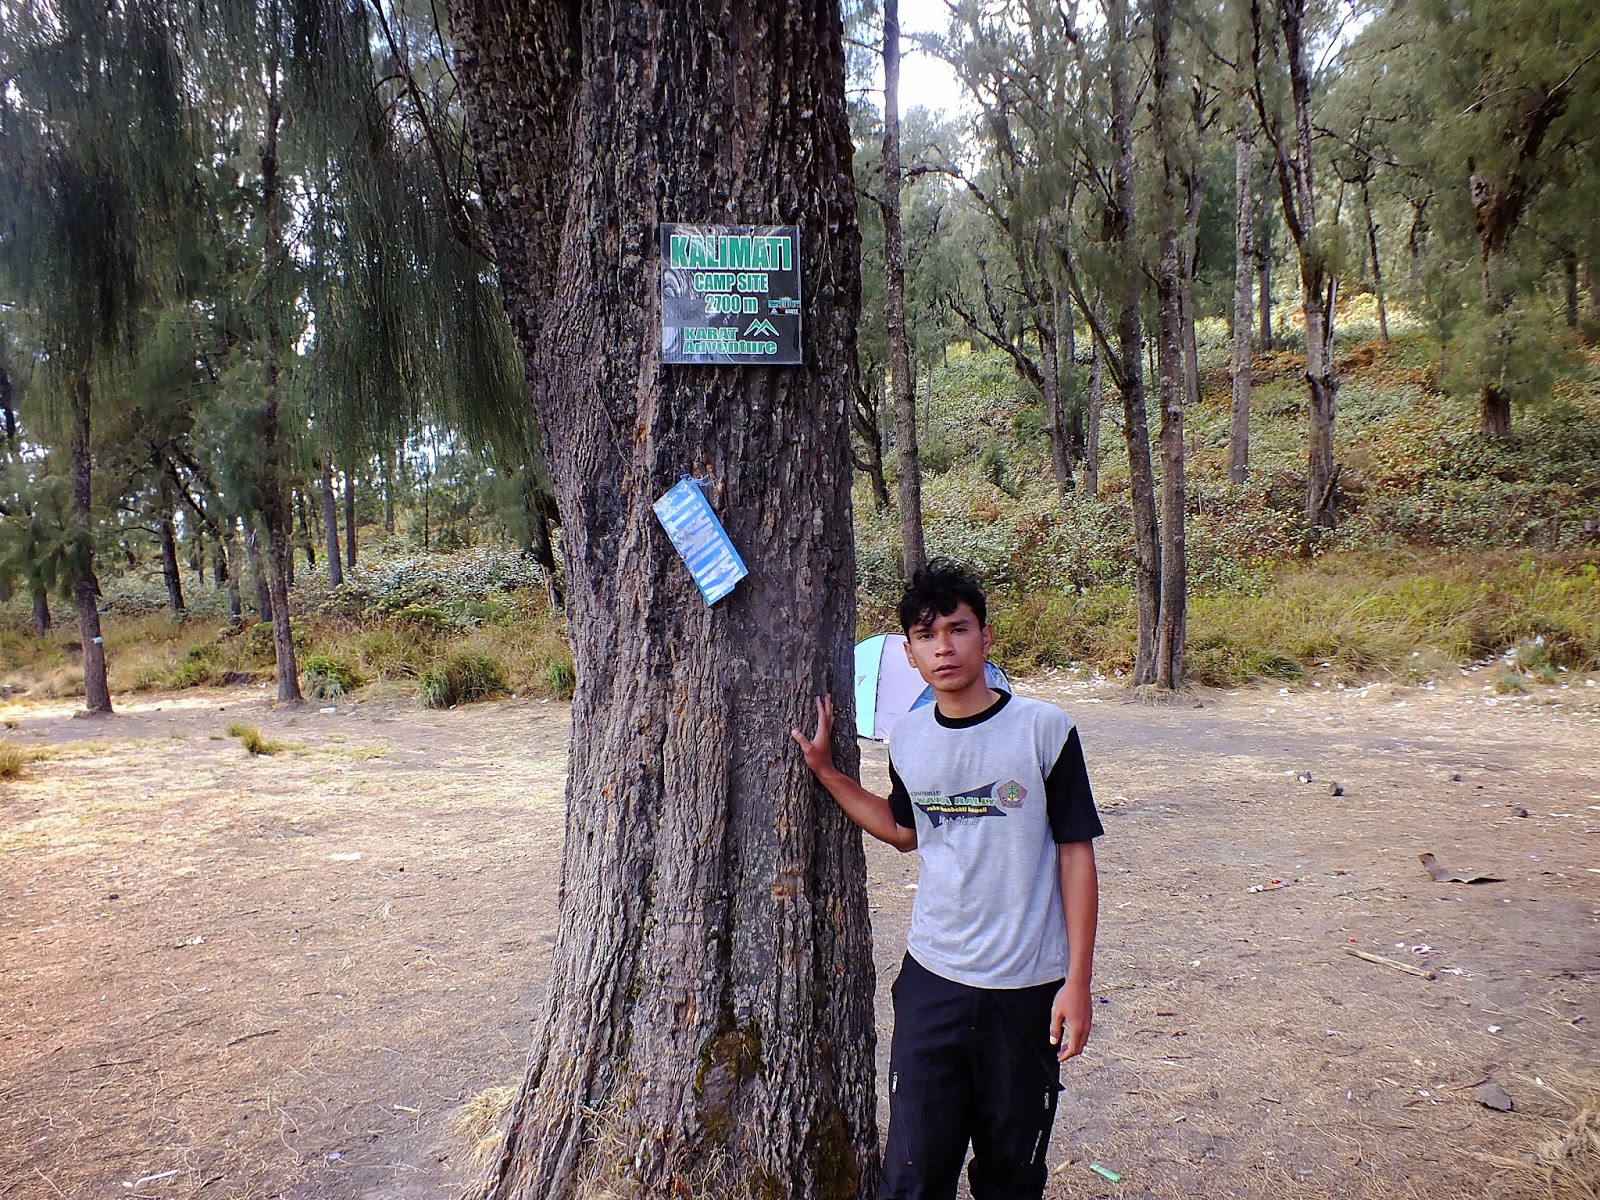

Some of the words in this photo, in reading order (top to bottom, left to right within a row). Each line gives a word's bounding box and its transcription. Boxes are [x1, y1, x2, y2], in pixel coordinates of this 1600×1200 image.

[670, 235, 792, 270] KALIMATI
[694, 273, 736, 292] CAMP
[737, 273, 769, 293] SITE
[705, 294, 742, 313] 2700
[743, 296, 758, 313] m
[683, 327, 739, 340] KARAT
[683, 340, 777, 355] Adventure
[954, 796, 996, 806] RALLY
